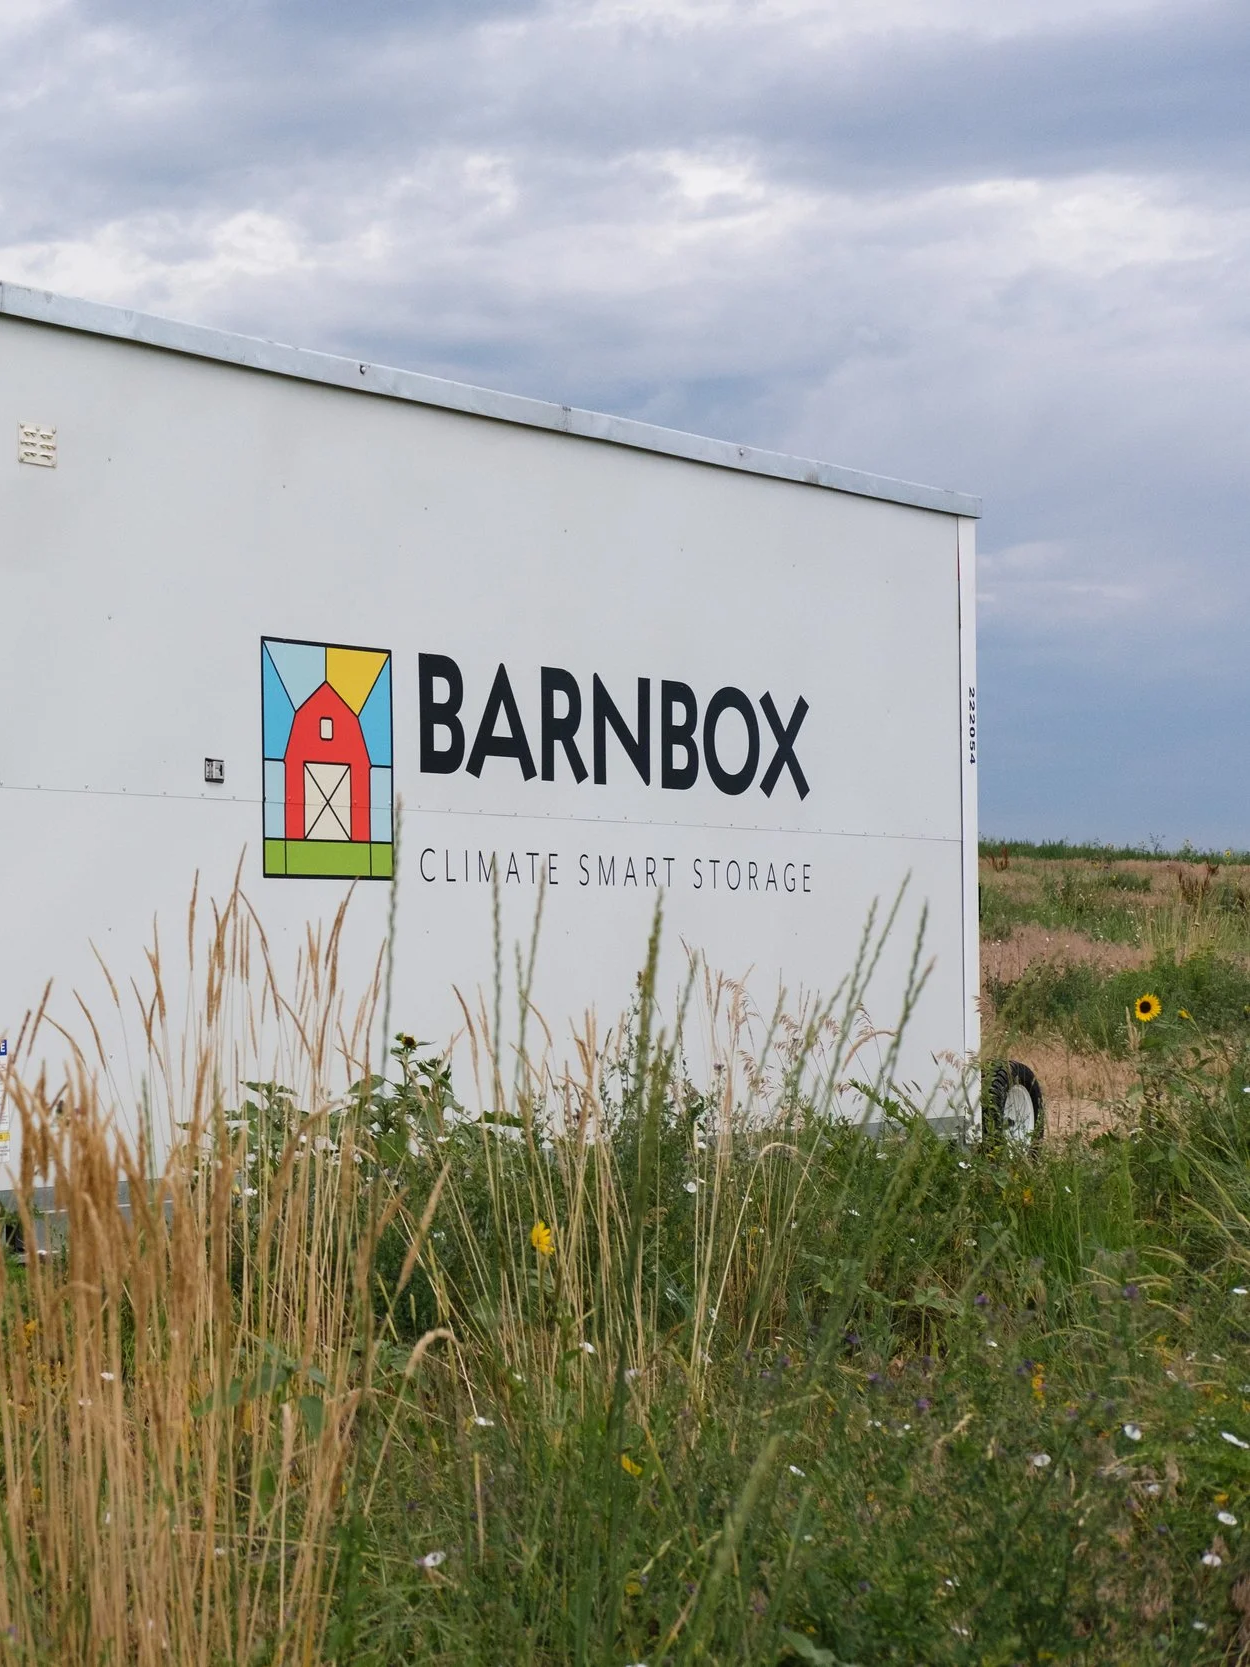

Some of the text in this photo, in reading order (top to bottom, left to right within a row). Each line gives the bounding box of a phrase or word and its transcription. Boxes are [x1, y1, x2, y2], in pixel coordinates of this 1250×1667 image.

[417, 651, 811, 802] BARNBOX
[968, 686, 976, 765] 222054
[419, 847, 812, 893] CLIMATE SMART STORAGE
